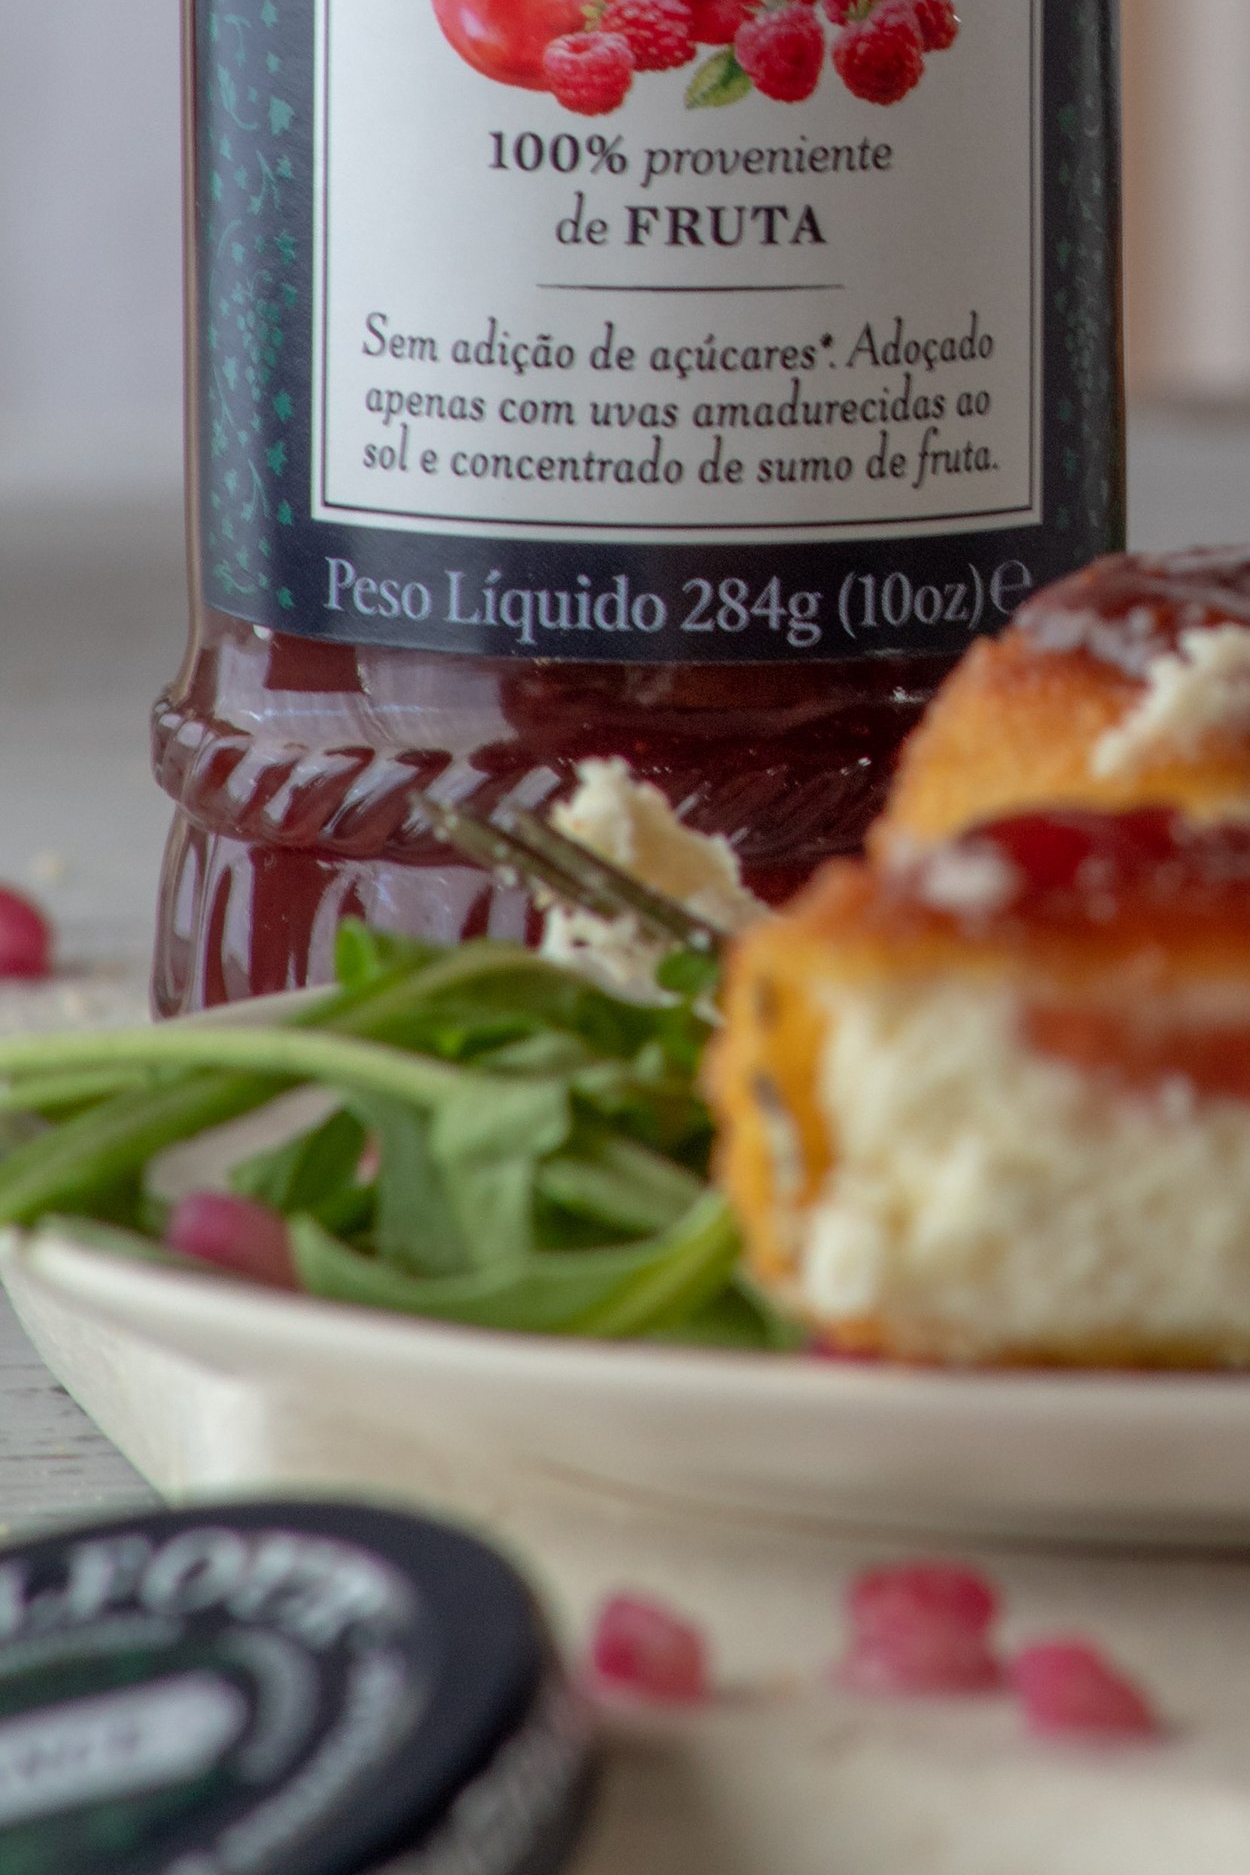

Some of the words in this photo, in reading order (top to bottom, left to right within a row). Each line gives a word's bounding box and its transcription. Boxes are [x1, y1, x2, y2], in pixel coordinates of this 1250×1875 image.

[488, 131, 628, 175] 100%
[641, 135, 894, 188] proveniente
[556, 190, 608, 246] de
[624, 203, 828, 248] FRUTA
[362, 312, 440, 363] Sem
[451, 315, 575, 375] adição
[589, 321, 636, 371] de
[846, 309, 995, 372] Adoçado
[365, 387, 486, 426] apenas
[499, 397, 575, 425] com
[590, 401, 680, 428] uvas
[692, 371, 946, 428] amadurecidas
[956, 389, 991, 418] ao
[362, 422, 409, 472] sol
[419, 447, 439, 475] e
[450, 433, 685, 485] concentrado
[698, 433, 745, 485] de
[756, 454, 854, 484] sumo
[866, 428, 907, 480] de
[911, 425, 999, 490] fruta.
[322, 556, 430, 621] Peso
[443, 565, 667, 645] Líquido
[679, 576, 823, 649] 284g
